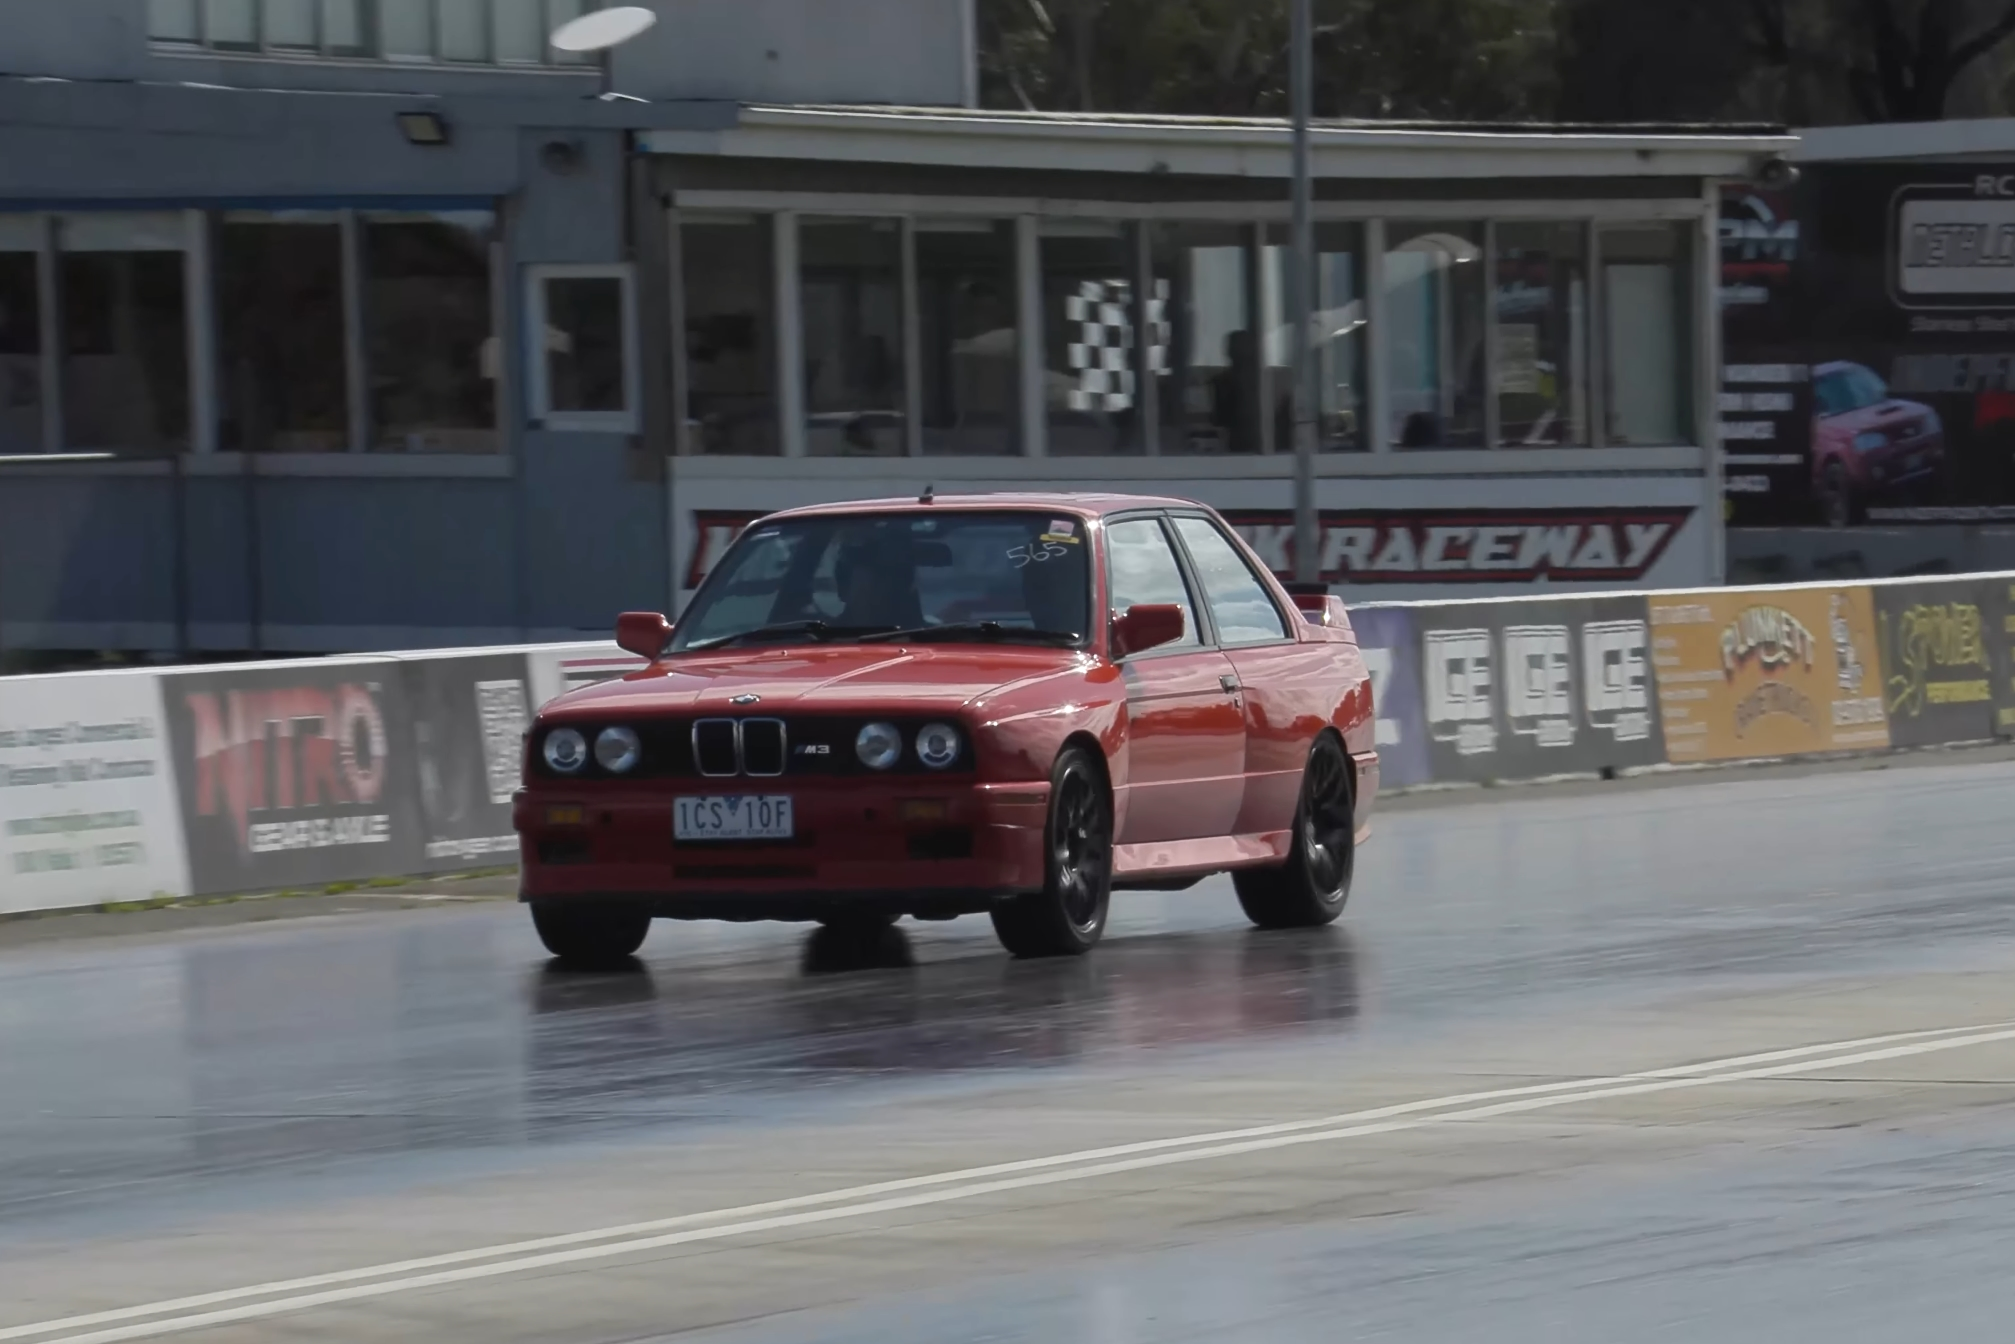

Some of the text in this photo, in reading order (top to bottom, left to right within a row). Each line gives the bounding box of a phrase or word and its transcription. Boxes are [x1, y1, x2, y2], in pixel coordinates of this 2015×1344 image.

[1006, 541, 1068, 569] 565
[1322, 522, 1675, 573] RACEWAY
[185, 682, 388, 848] NITRO
[804, 744, 830, 754] M3
